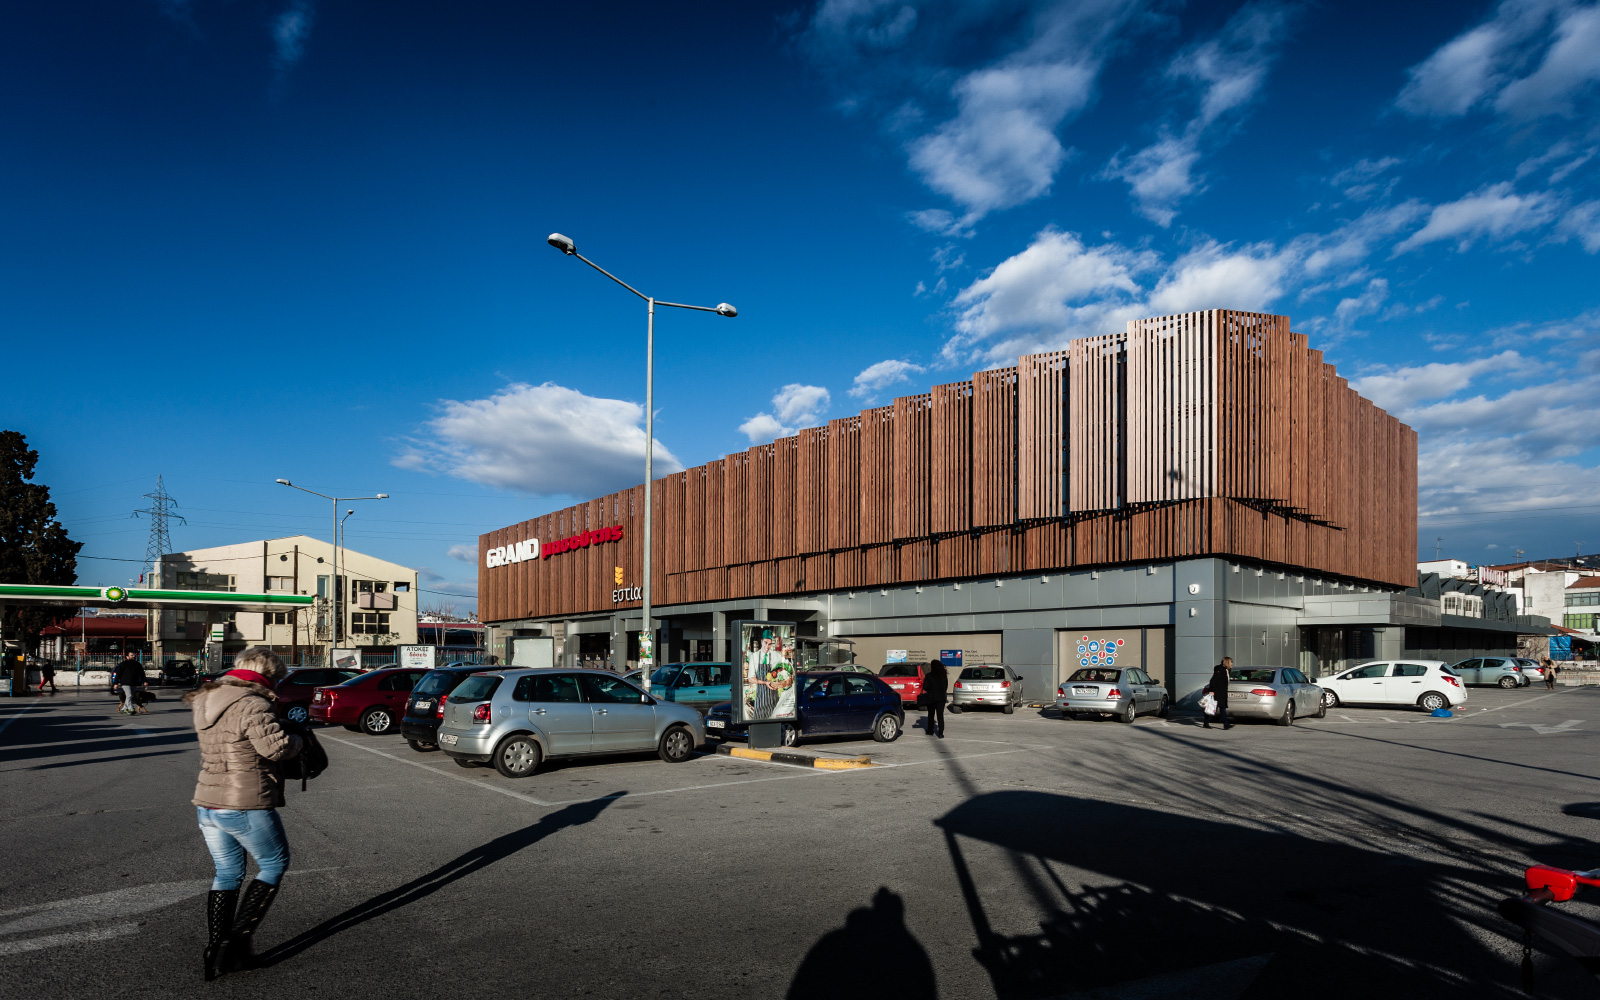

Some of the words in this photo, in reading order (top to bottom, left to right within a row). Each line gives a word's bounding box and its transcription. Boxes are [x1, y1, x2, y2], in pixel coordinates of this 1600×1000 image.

[486, 538, 540, 569] GRAND
[541, 525, 624, 559] μασούτης
[612, 582, 642, 603] εστία
